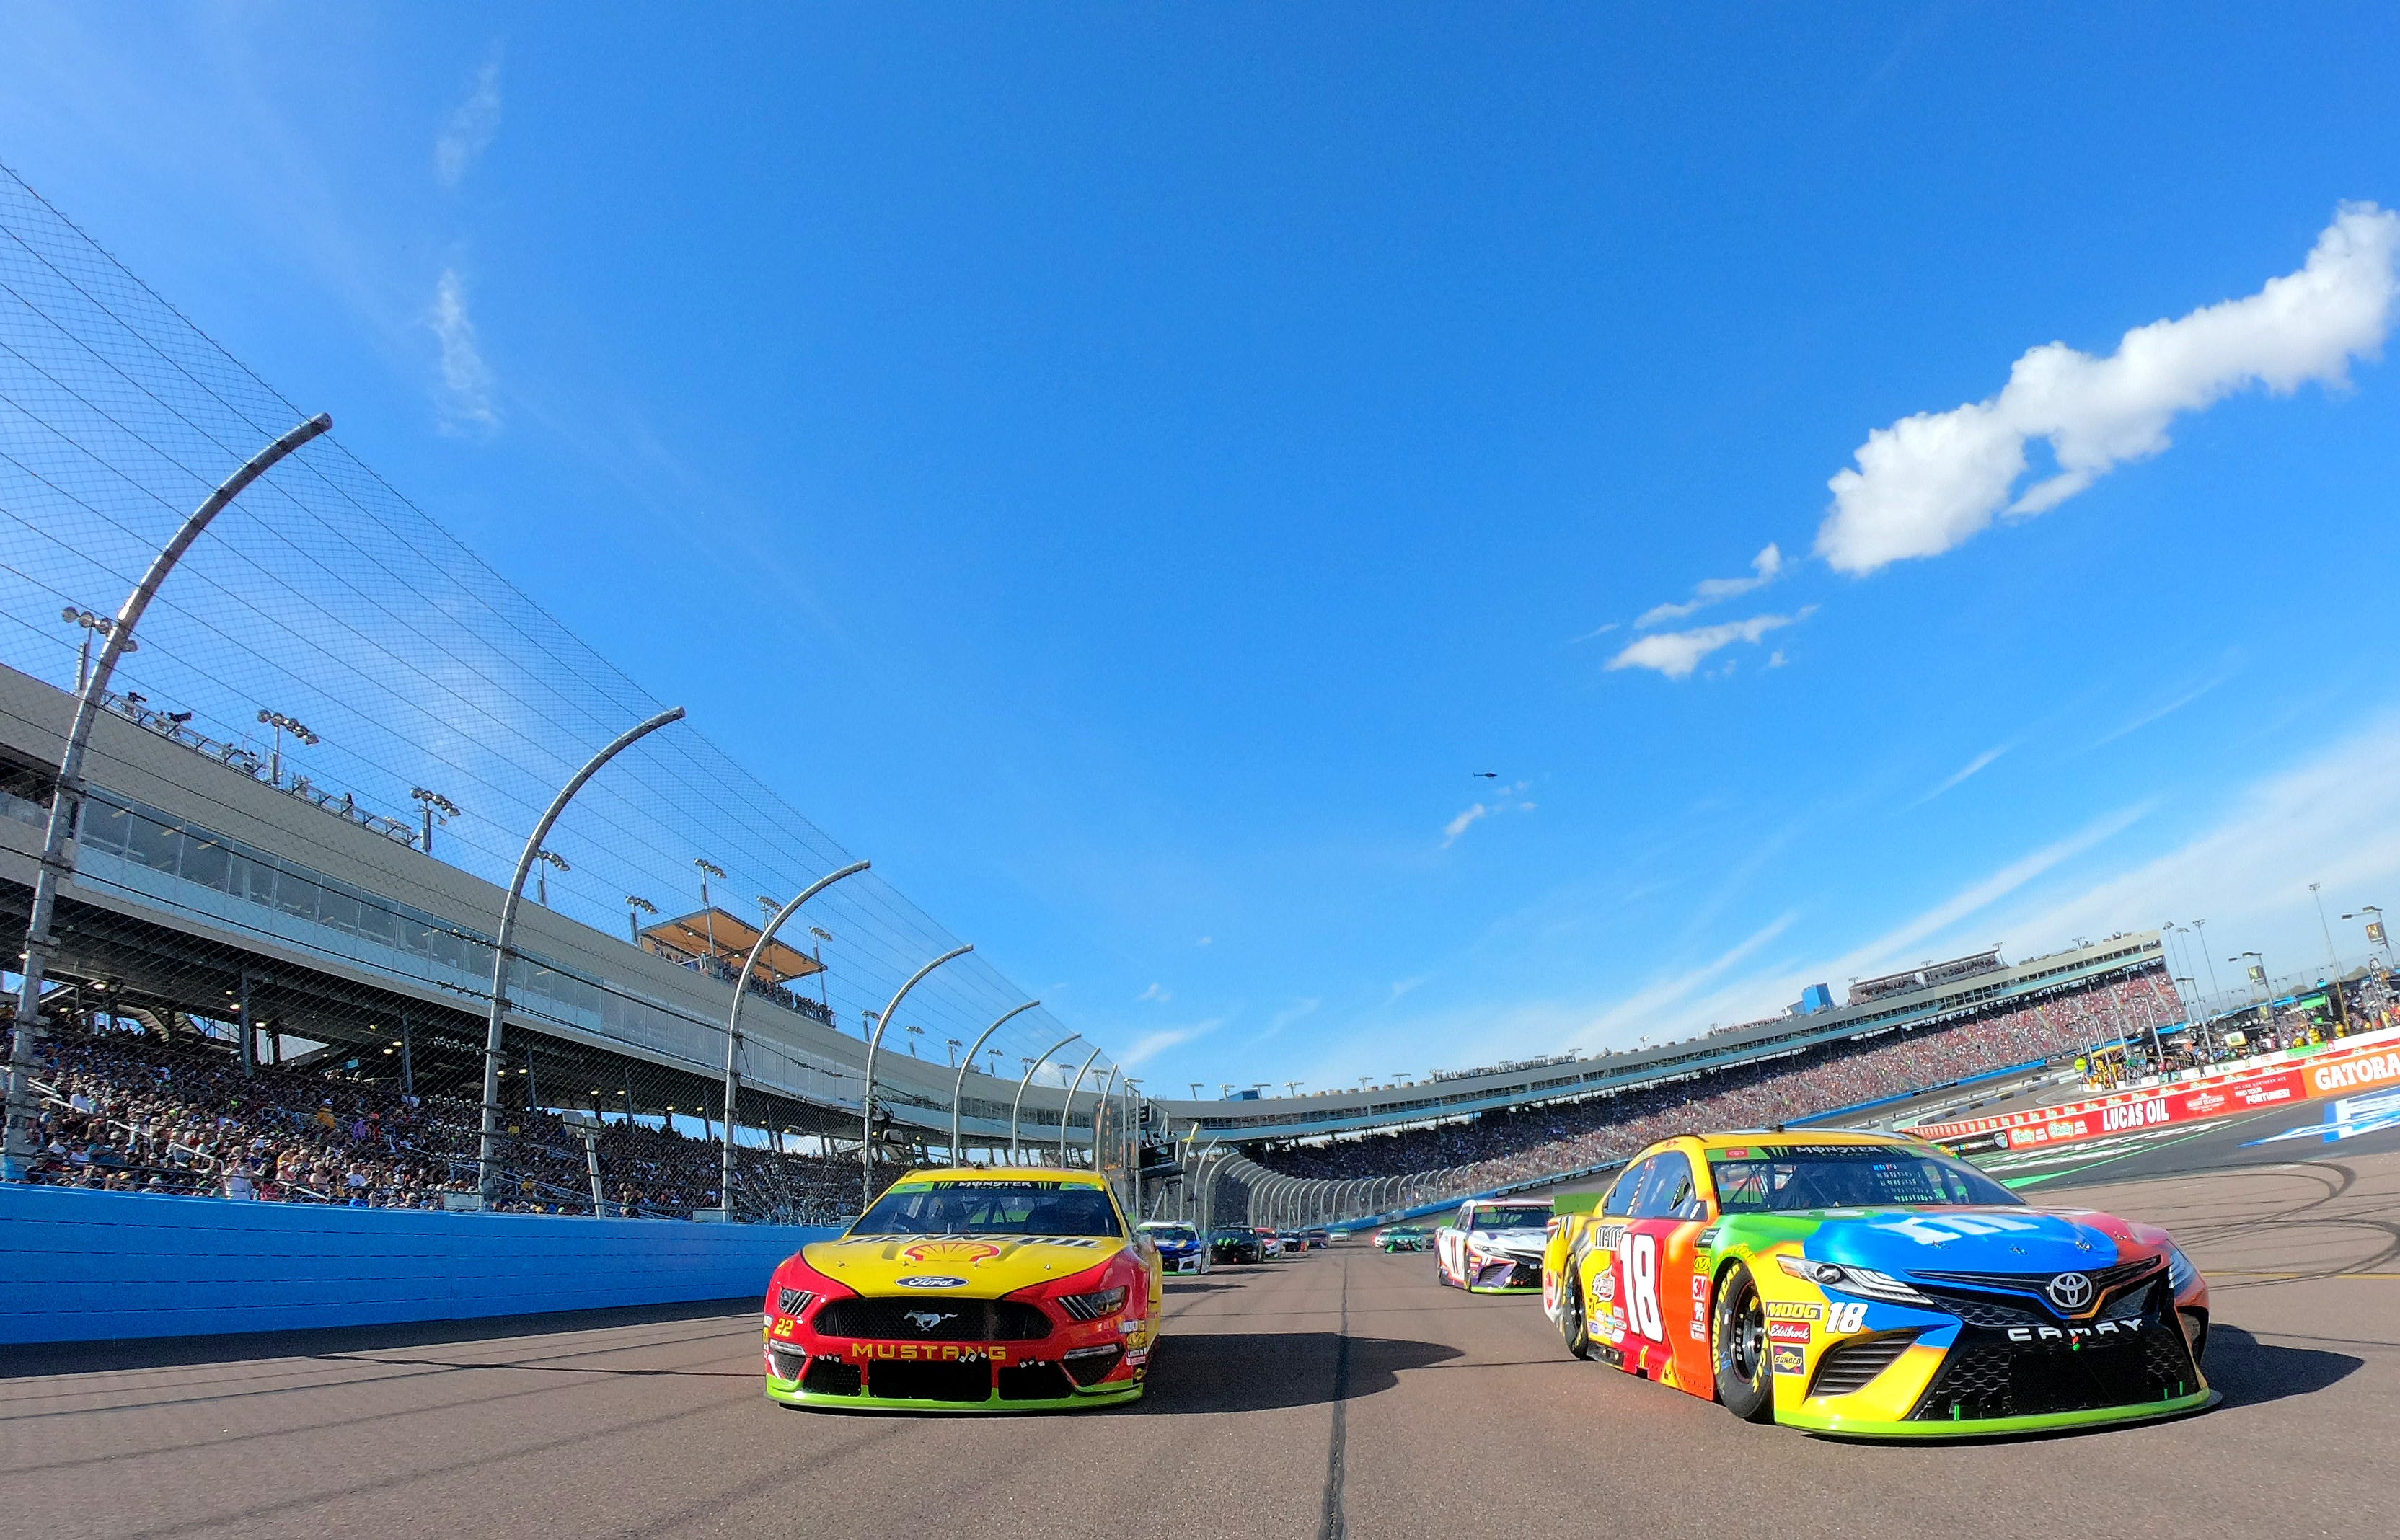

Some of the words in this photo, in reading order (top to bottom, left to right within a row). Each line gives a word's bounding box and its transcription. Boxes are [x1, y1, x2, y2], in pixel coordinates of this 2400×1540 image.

[2104, 1102, 2144, 1131] LUCAS
[2146, 1098, 2170, 1125] OIL
[909, 1277, 955, 1285] Ford
[1620, 1232, 1664, 1343] 18
[1694, 1278, 1706, 1297] 3M
[1767, 1304, 1818, 1319] MOOG
[1825, 1302, 1869, 1334] 18
[774, 1318, 794, 1337] 22
[1770, 1324, 1809, 1340] Edelbrock
[852, 1343, 1007, 1360] MUSTANG
[1775, 1356, 1801, 1365] SUNOCO
